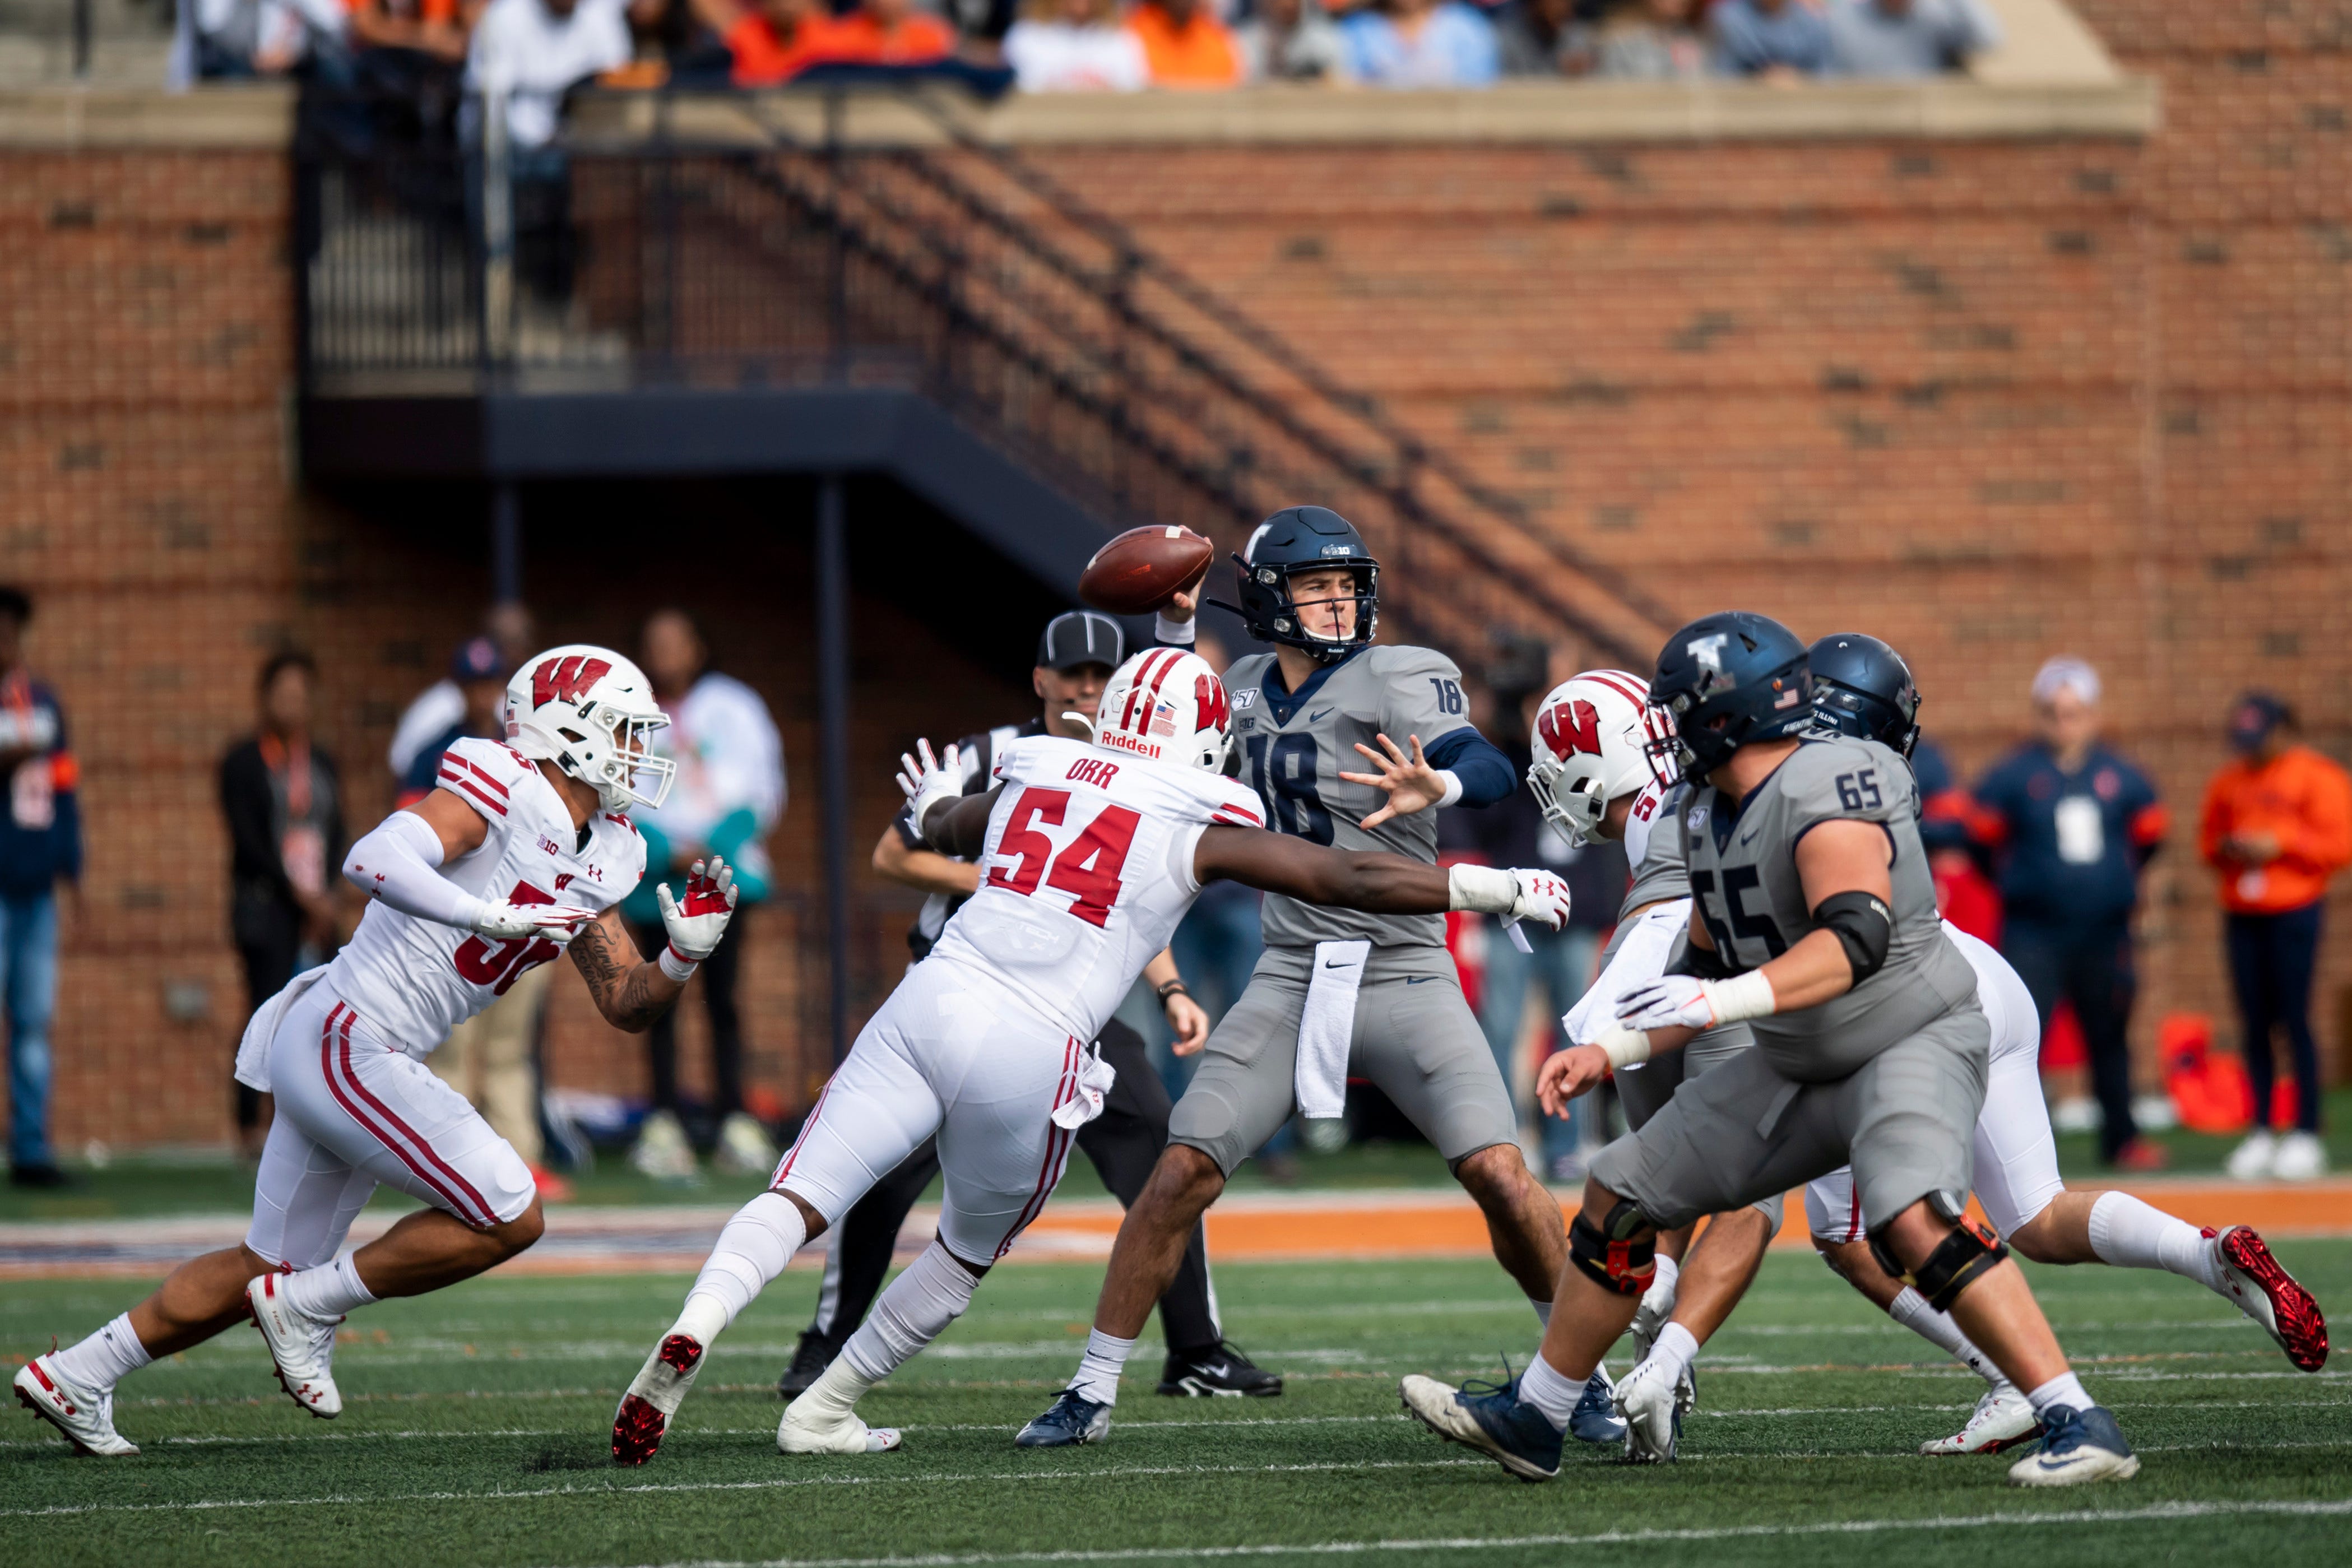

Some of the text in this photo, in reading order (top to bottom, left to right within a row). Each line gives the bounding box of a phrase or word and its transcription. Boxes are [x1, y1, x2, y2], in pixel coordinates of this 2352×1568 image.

[530, 655, 613, 712] W
[1194, 672, 1231, 735] W
[1428, 678, 1462, 715] 18
[1101, 731, 1161, 759] Riddell
[1538, 698, 1603, 763] W
[1065, 758, 1120, 790] ORR
[1246, 732, 1335, 847] 18
[1835, 769, 1882, 811] 65
[986, 787, 1142, 929] 54
[1690, 864, 1789, 970] 65
